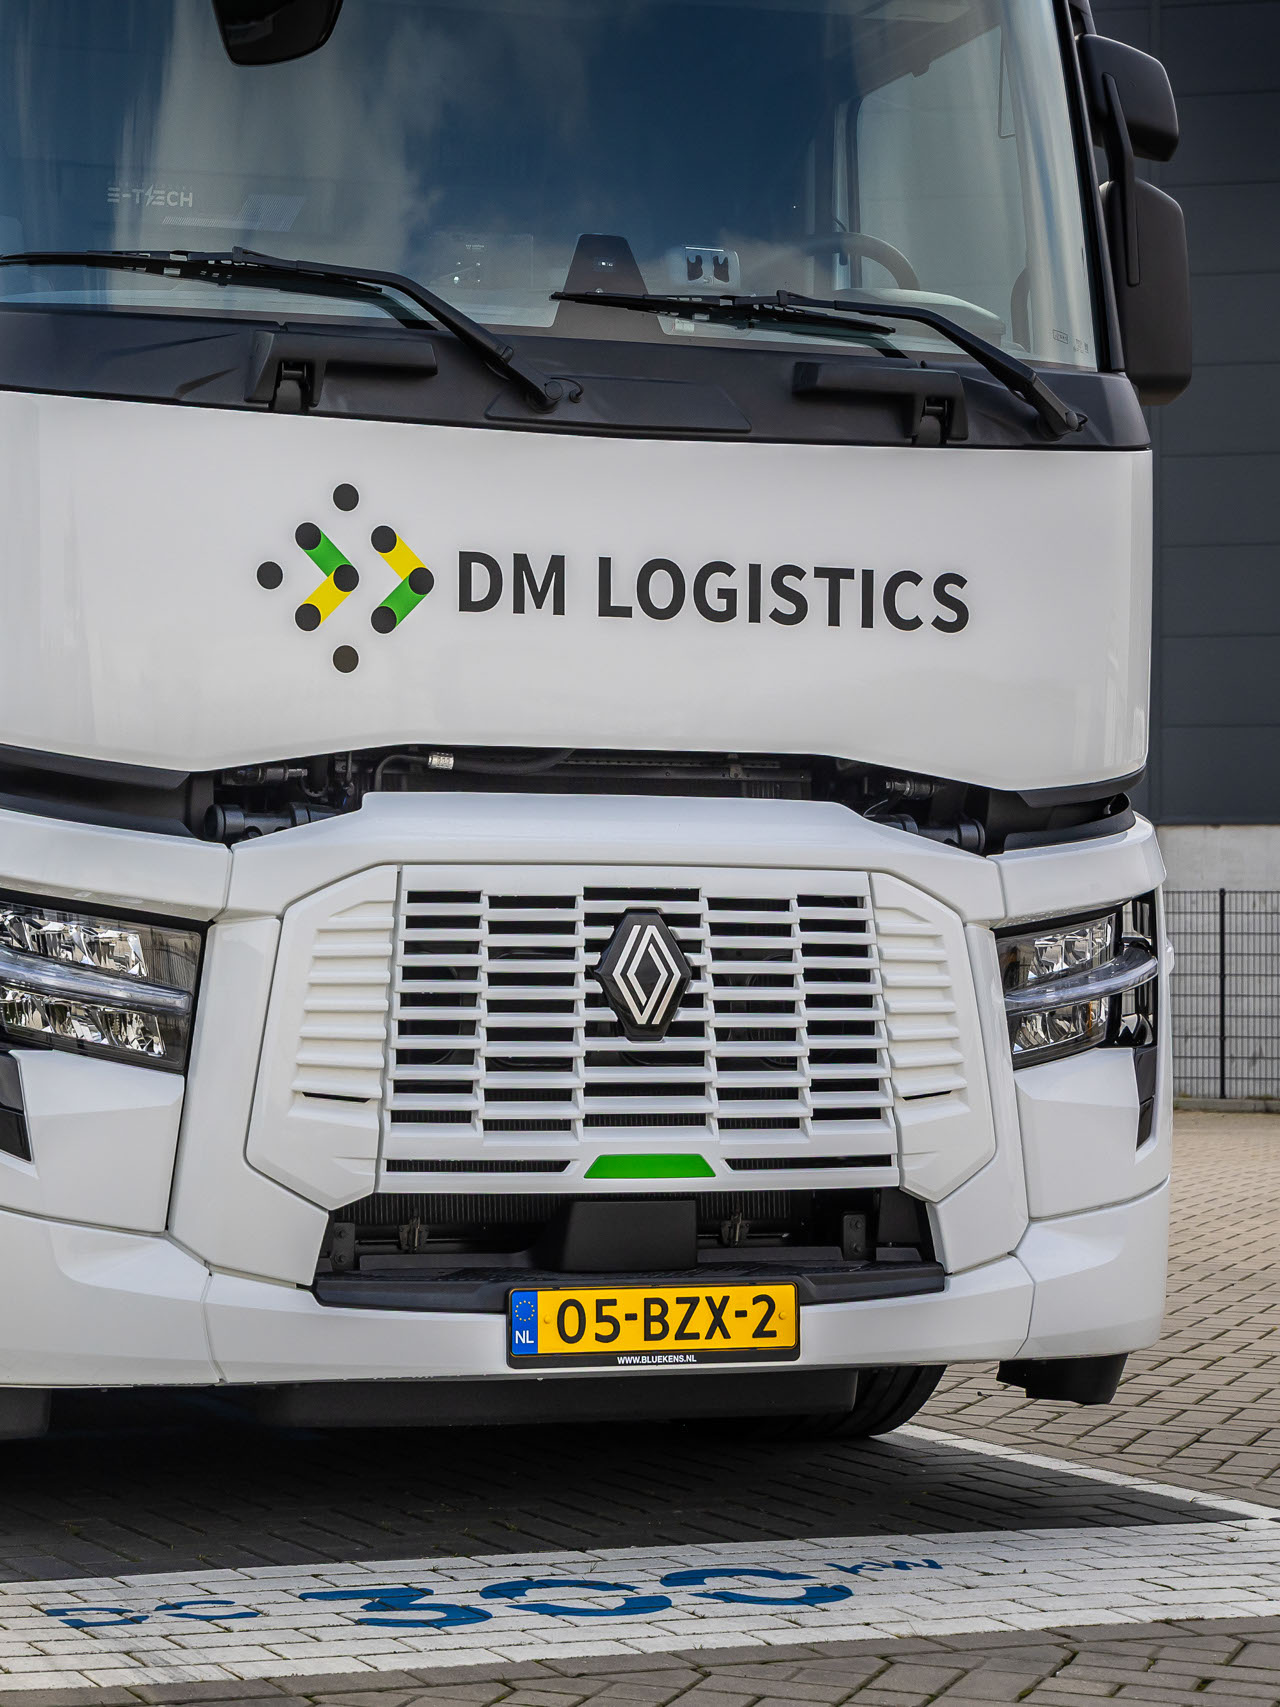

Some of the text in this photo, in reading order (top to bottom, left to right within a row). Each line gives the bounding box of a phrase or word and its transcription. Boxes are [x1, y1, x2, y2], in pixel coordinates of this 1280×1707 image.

[458, 549, 970, 635] DM LOGISTICS
[514, 1330, 535, 1345] NL
[556, 1293, 778, 1345] 05-BZX-2
[617, 1354, 697, 1365] WWW.BLUEKENS.NL
[46, 1599, 262, 1628] DC
[299, 1568, 856, 1629] 300
